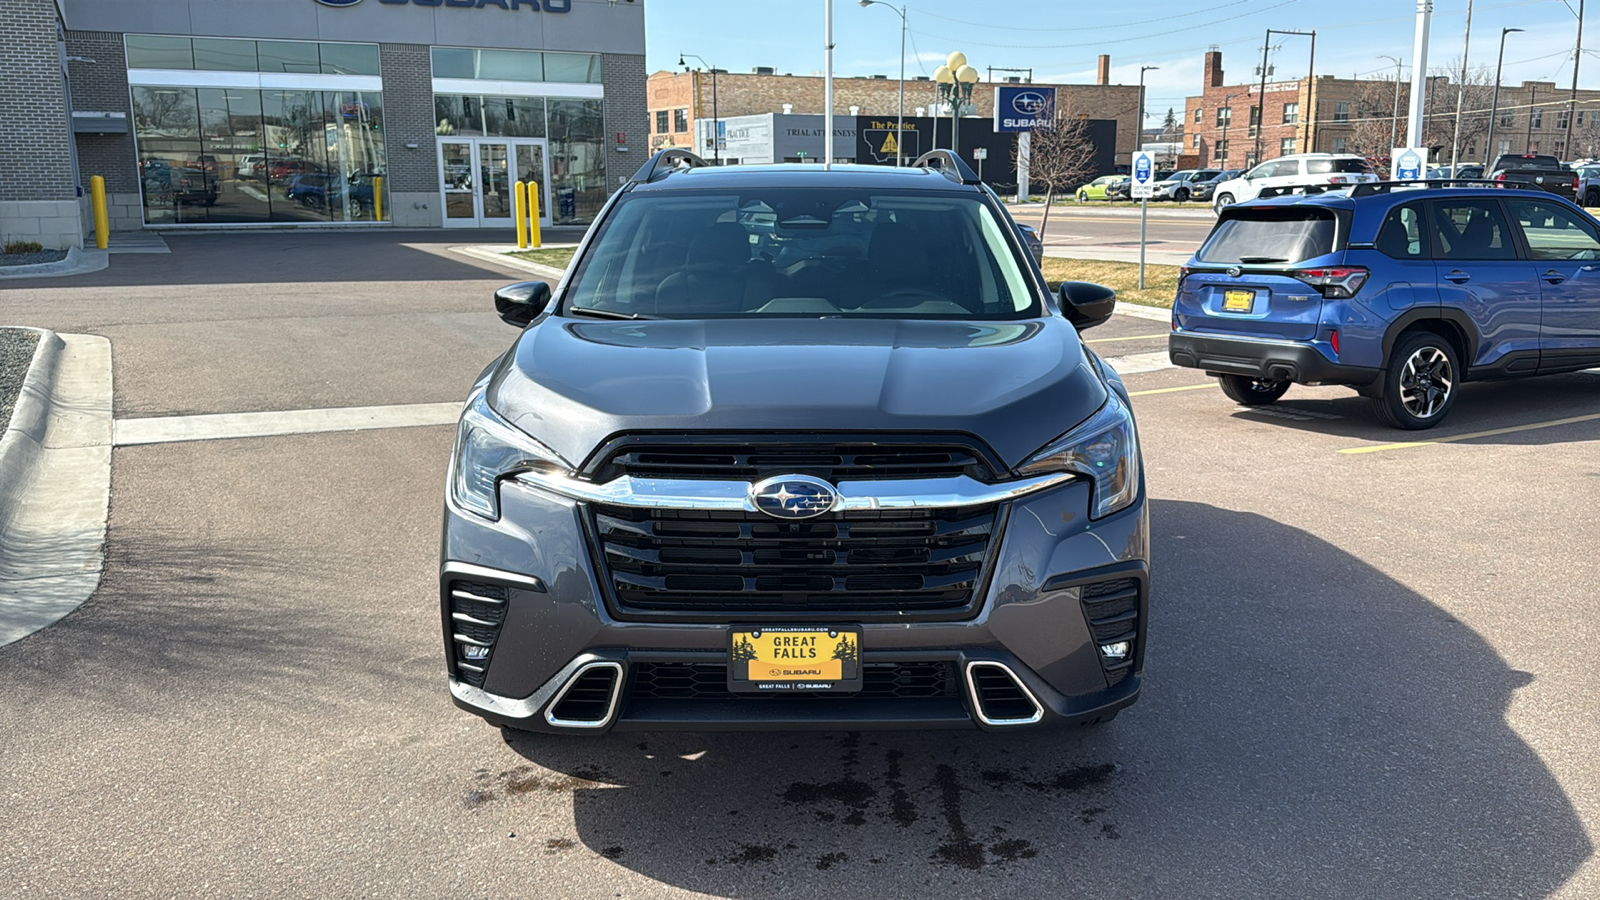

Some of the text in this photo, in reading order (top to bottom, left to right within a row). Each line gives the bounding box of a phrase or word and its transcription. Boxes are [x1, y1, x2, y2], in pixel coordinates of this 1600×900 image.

[871, 121, 916, 130] The Pratice
[1003, 119, 1051, 127] SUBARU
[786, 129, 856, 137] TRIAL ATTRNEYS
[773, 636, 817, 647] GREAT
[774, 647, 817, 659] FALLS
